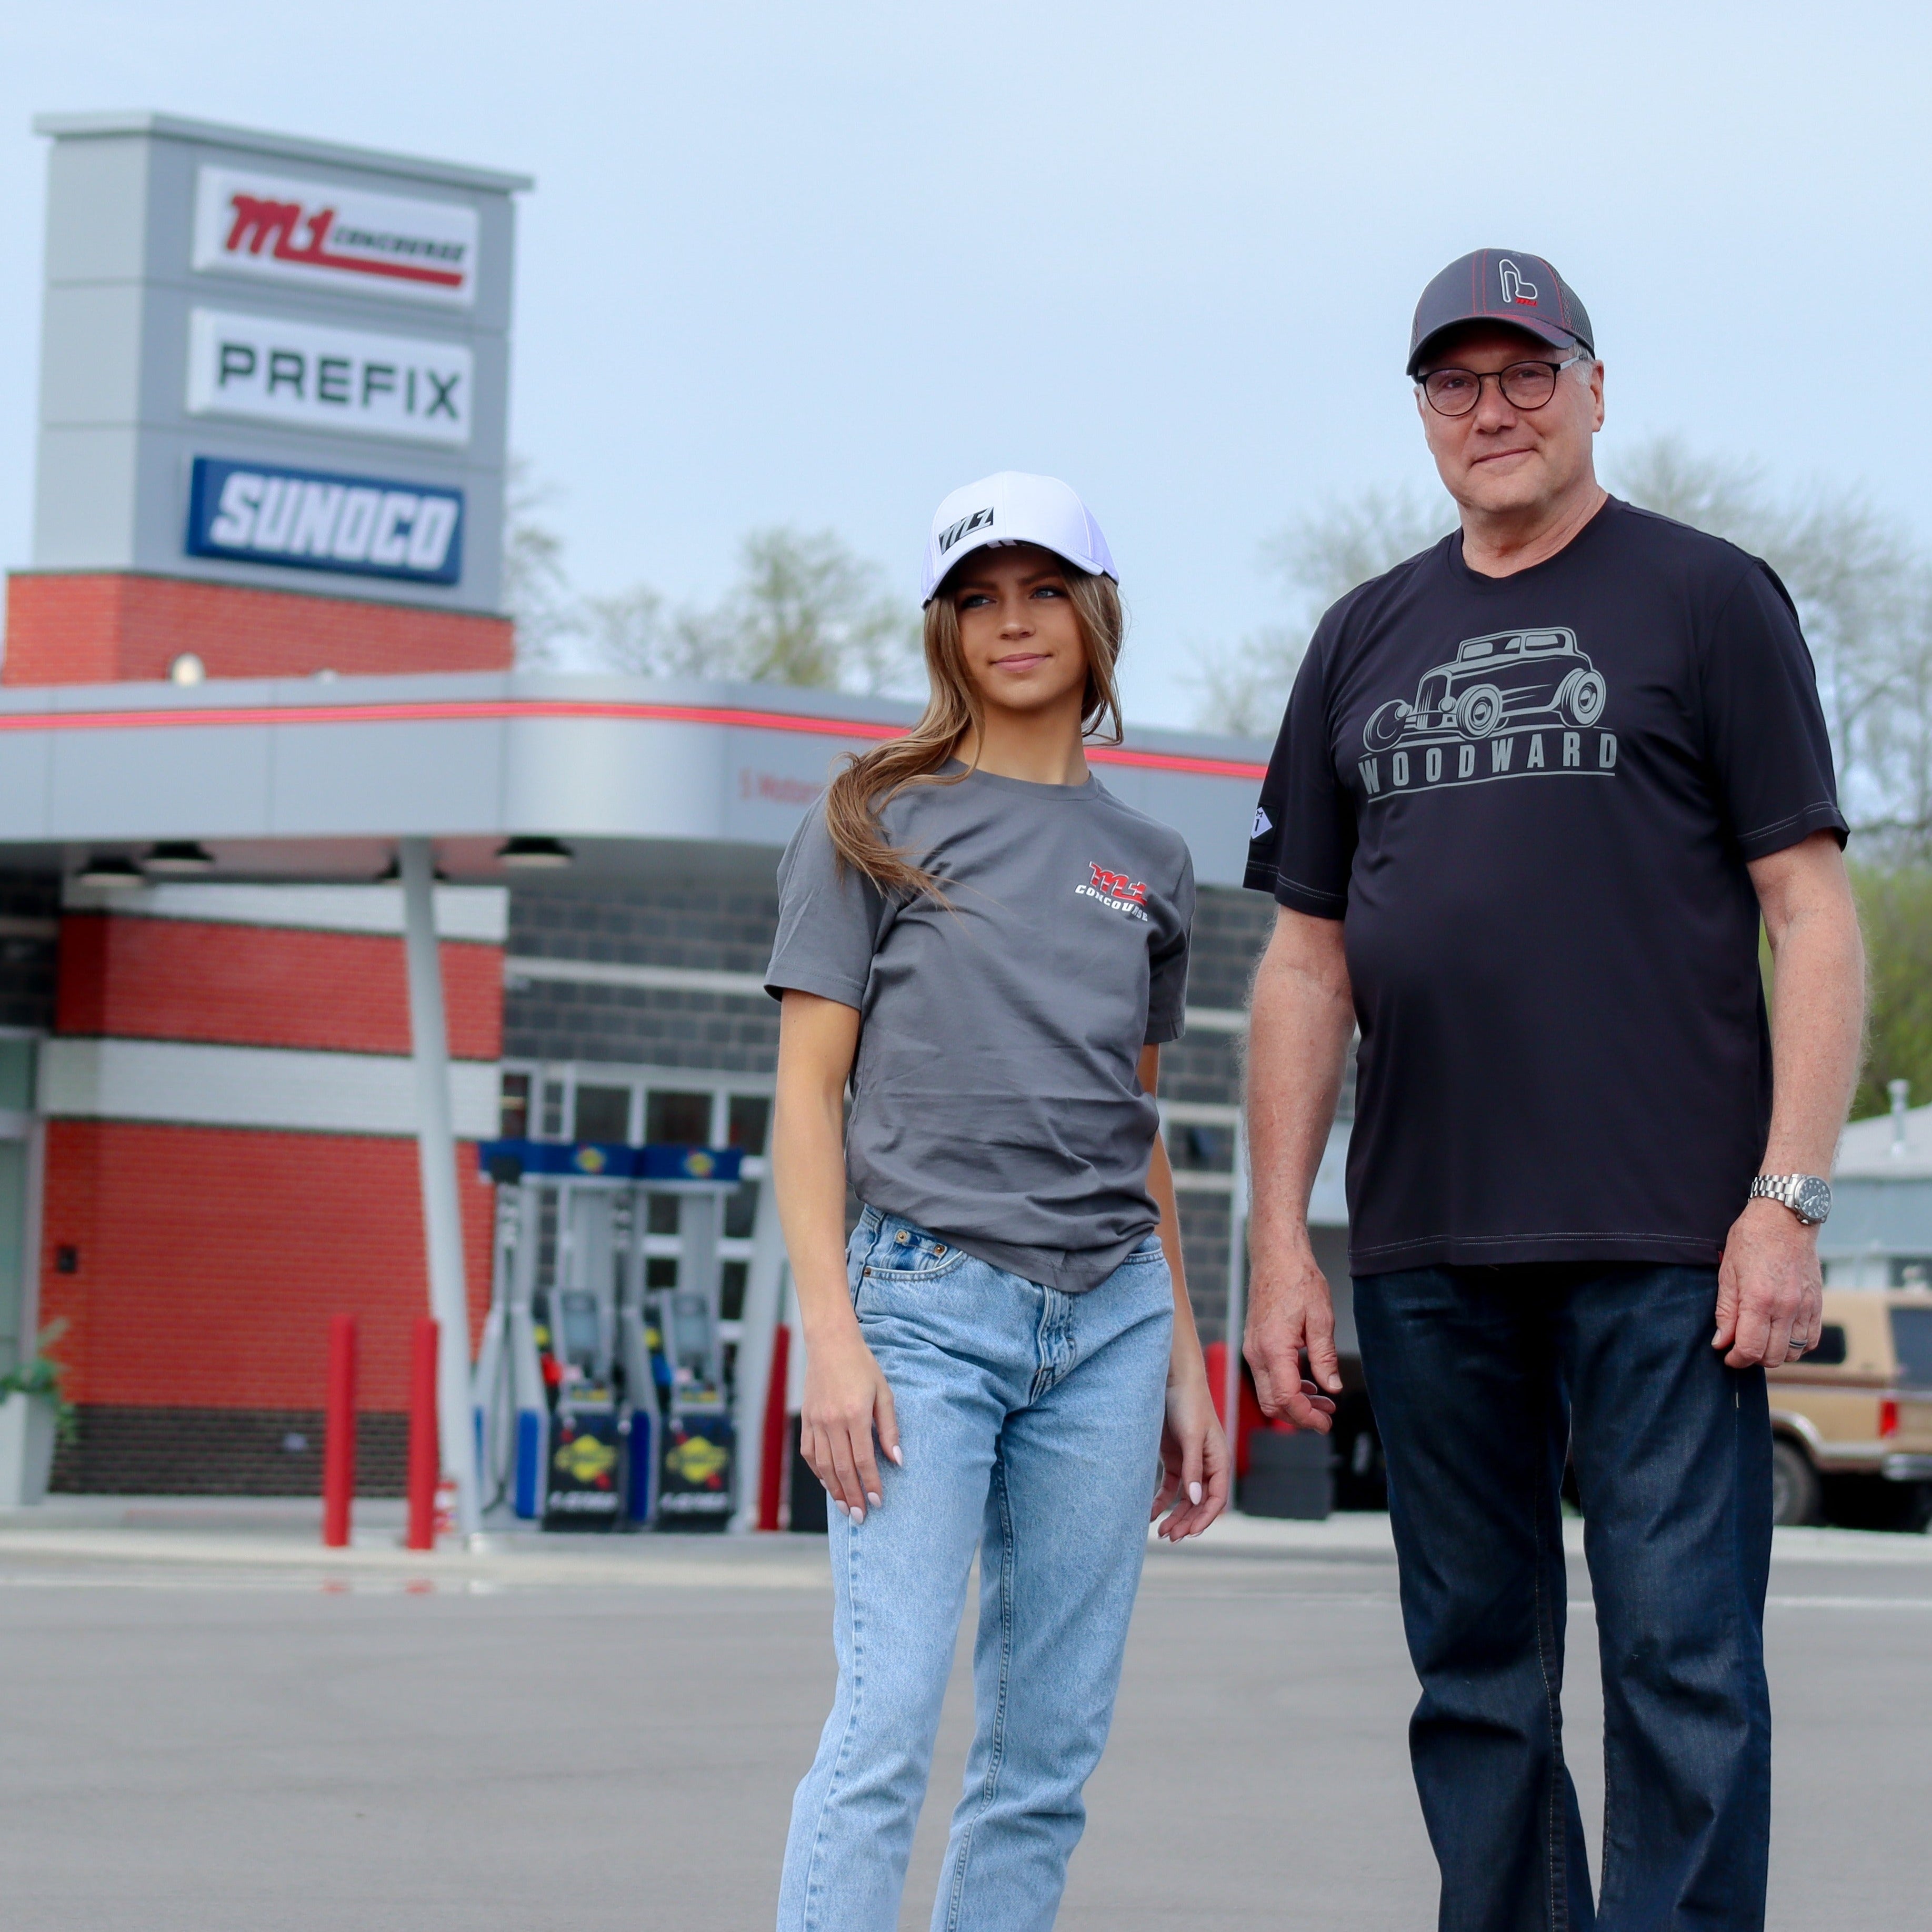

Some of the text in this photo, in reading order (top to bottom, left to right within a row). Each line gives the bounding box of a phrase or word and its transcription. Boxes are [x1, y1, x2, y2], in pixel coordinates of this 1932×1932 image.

[217, 341, 461, 421] PREFIX
[211, 471, 461, 573] SUNOCO
[1358, 731, 1617, 794] WOODWARD
[1075, 884, 1148, 922] CONCOURSE
